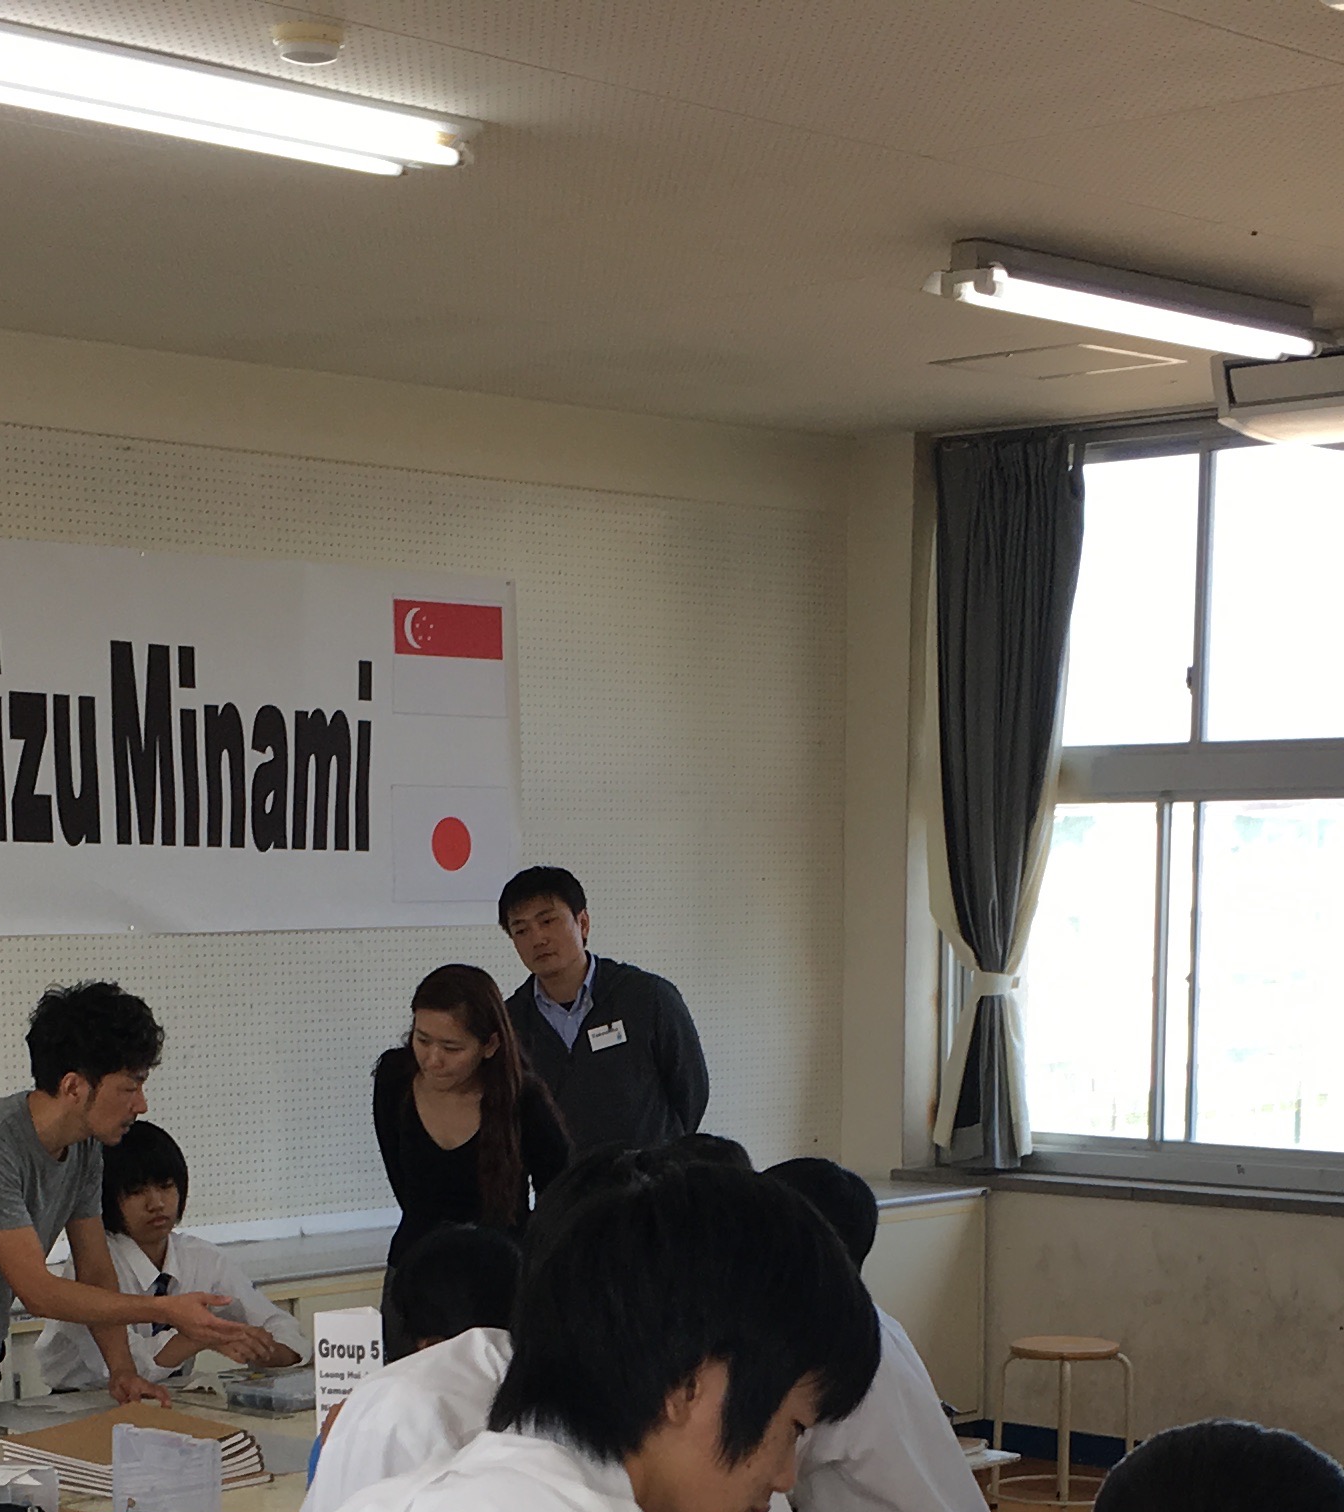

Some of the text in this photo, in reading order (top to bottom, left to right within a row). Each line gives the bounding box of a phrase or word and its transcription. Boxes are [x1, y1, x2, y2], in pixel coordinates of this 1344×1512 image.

[109, 640, 373, 853] Minami
[318, 1338, 380, 1364] Group 5
